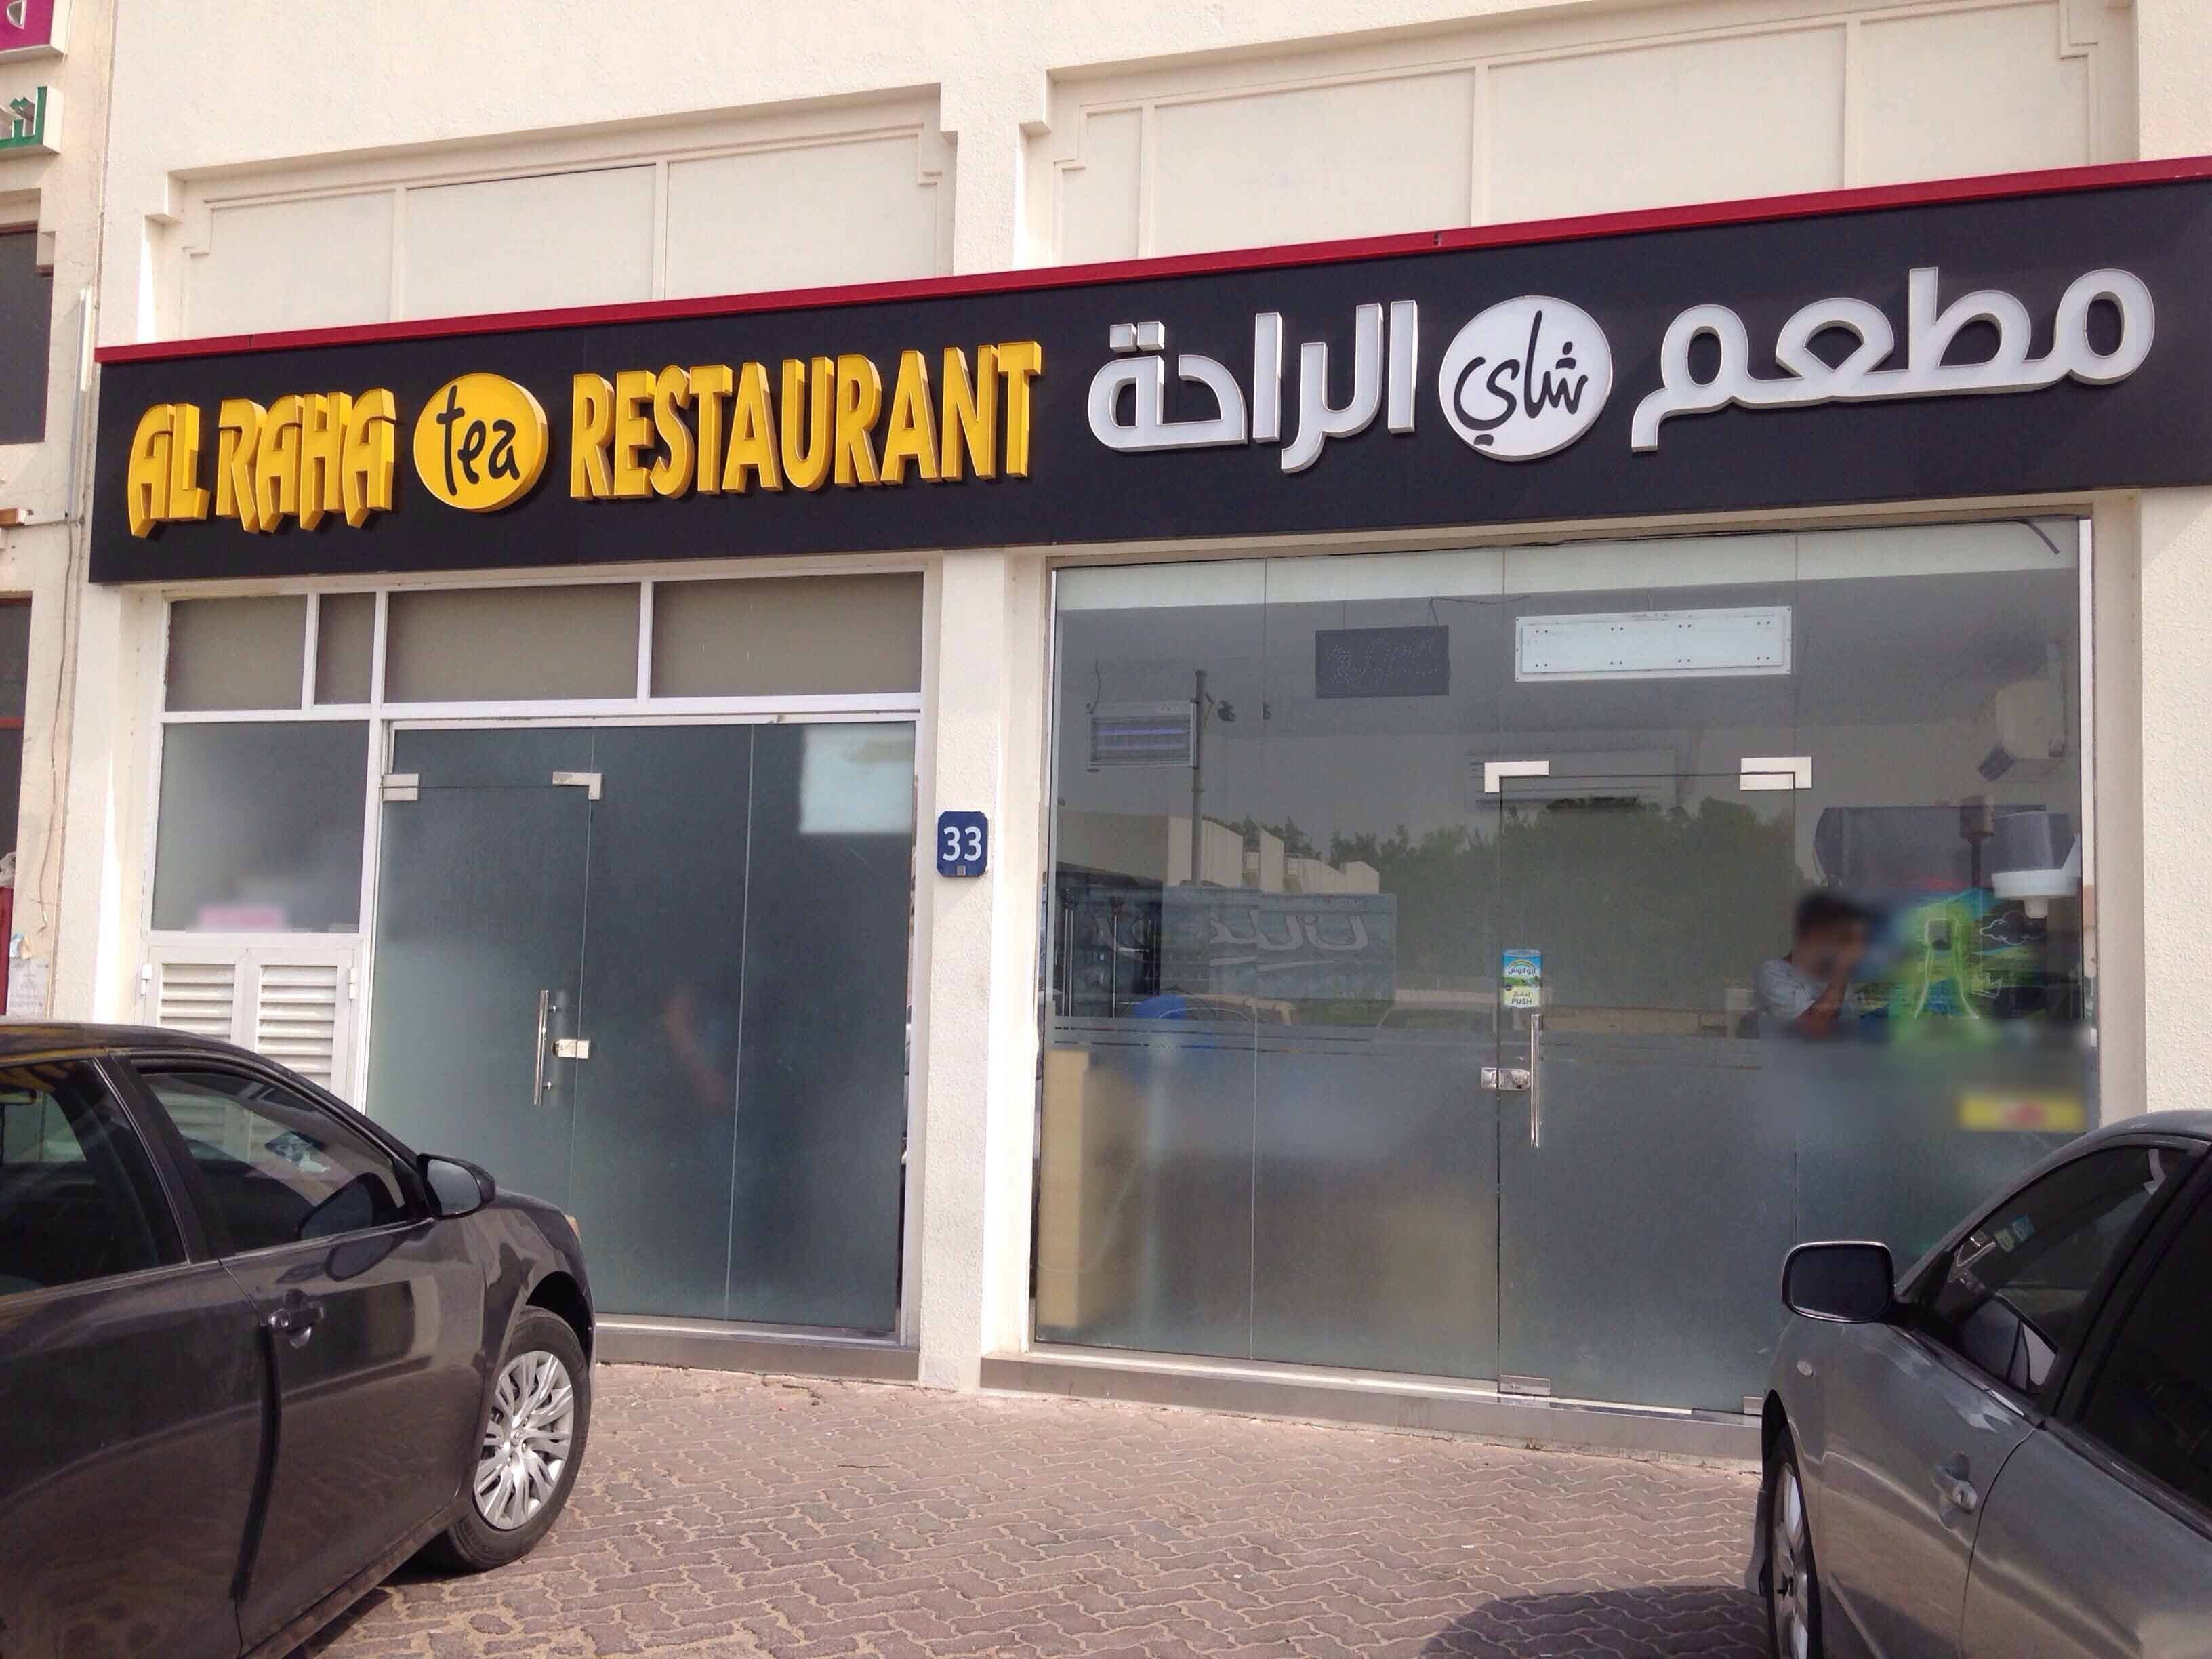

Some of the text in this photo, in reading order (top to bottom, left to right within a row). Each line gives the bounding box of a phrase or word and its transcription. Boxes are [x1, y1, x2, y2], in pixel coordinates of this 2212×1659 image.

[127, 341, 1042, 538] AL RAHA tea RESTAURANT
[1088, 267, 2156, 474] مطعم شاي الراحة
[943, 826, 982, 861] 33
